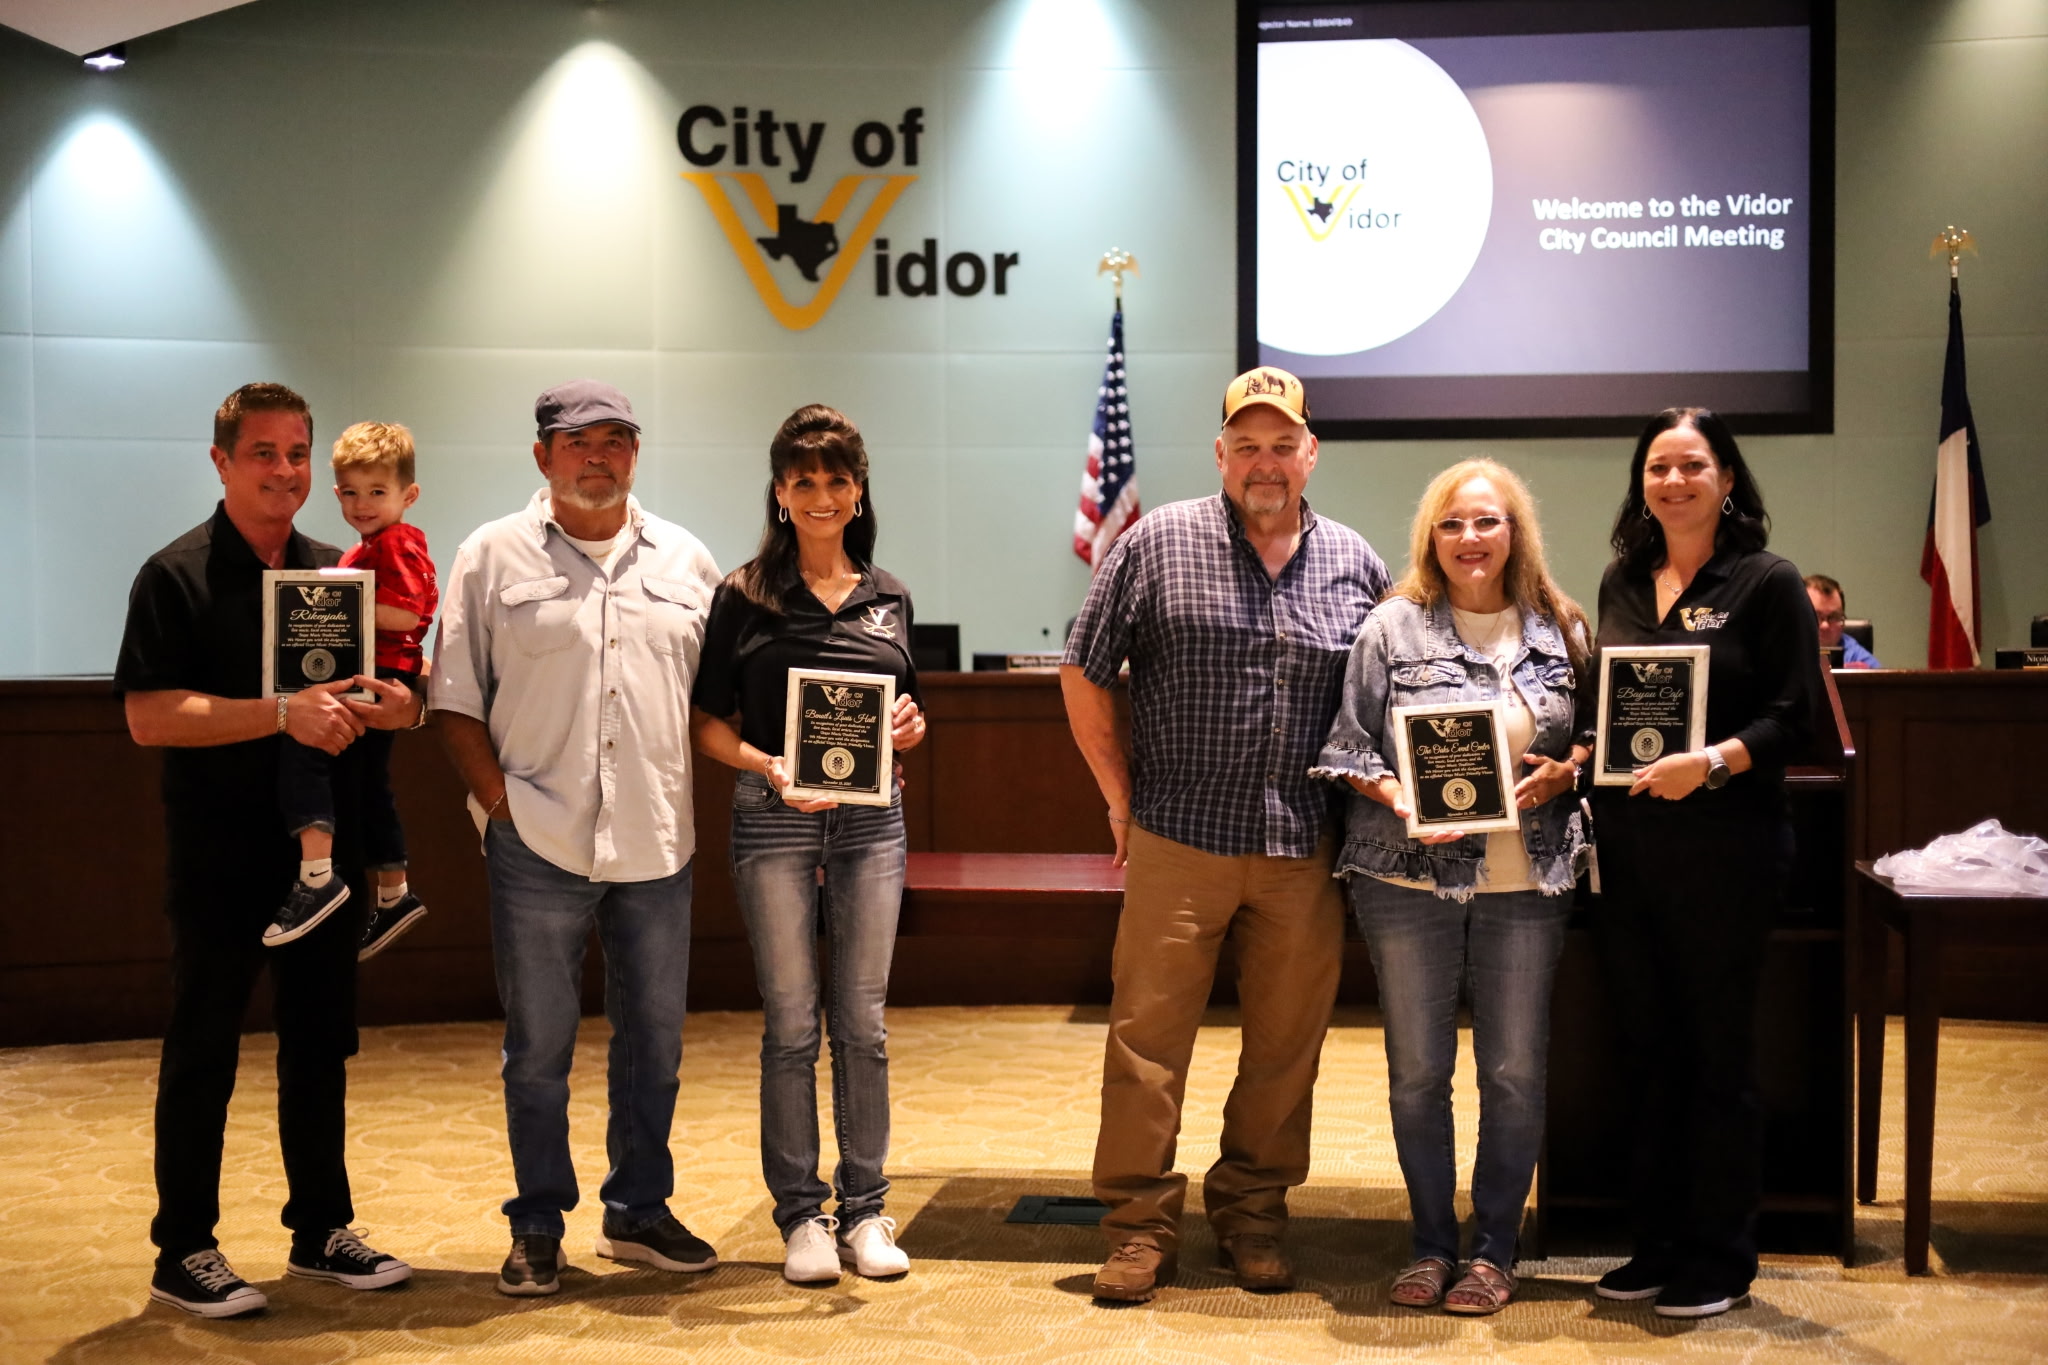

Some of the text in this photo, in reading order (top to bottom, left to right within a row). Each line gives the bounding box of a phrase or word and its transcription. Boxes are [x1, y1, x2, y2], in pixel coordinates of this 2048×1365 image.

[677, 105, 923, 183] City of
[1278, 159, 1367, 187] City of
[1532, 193, 1793, 220] Welcome to the Vidor
[1539, 224, 1785, 254] City Council Meeting
[290, 610, 348, 623] Rikenjaks
